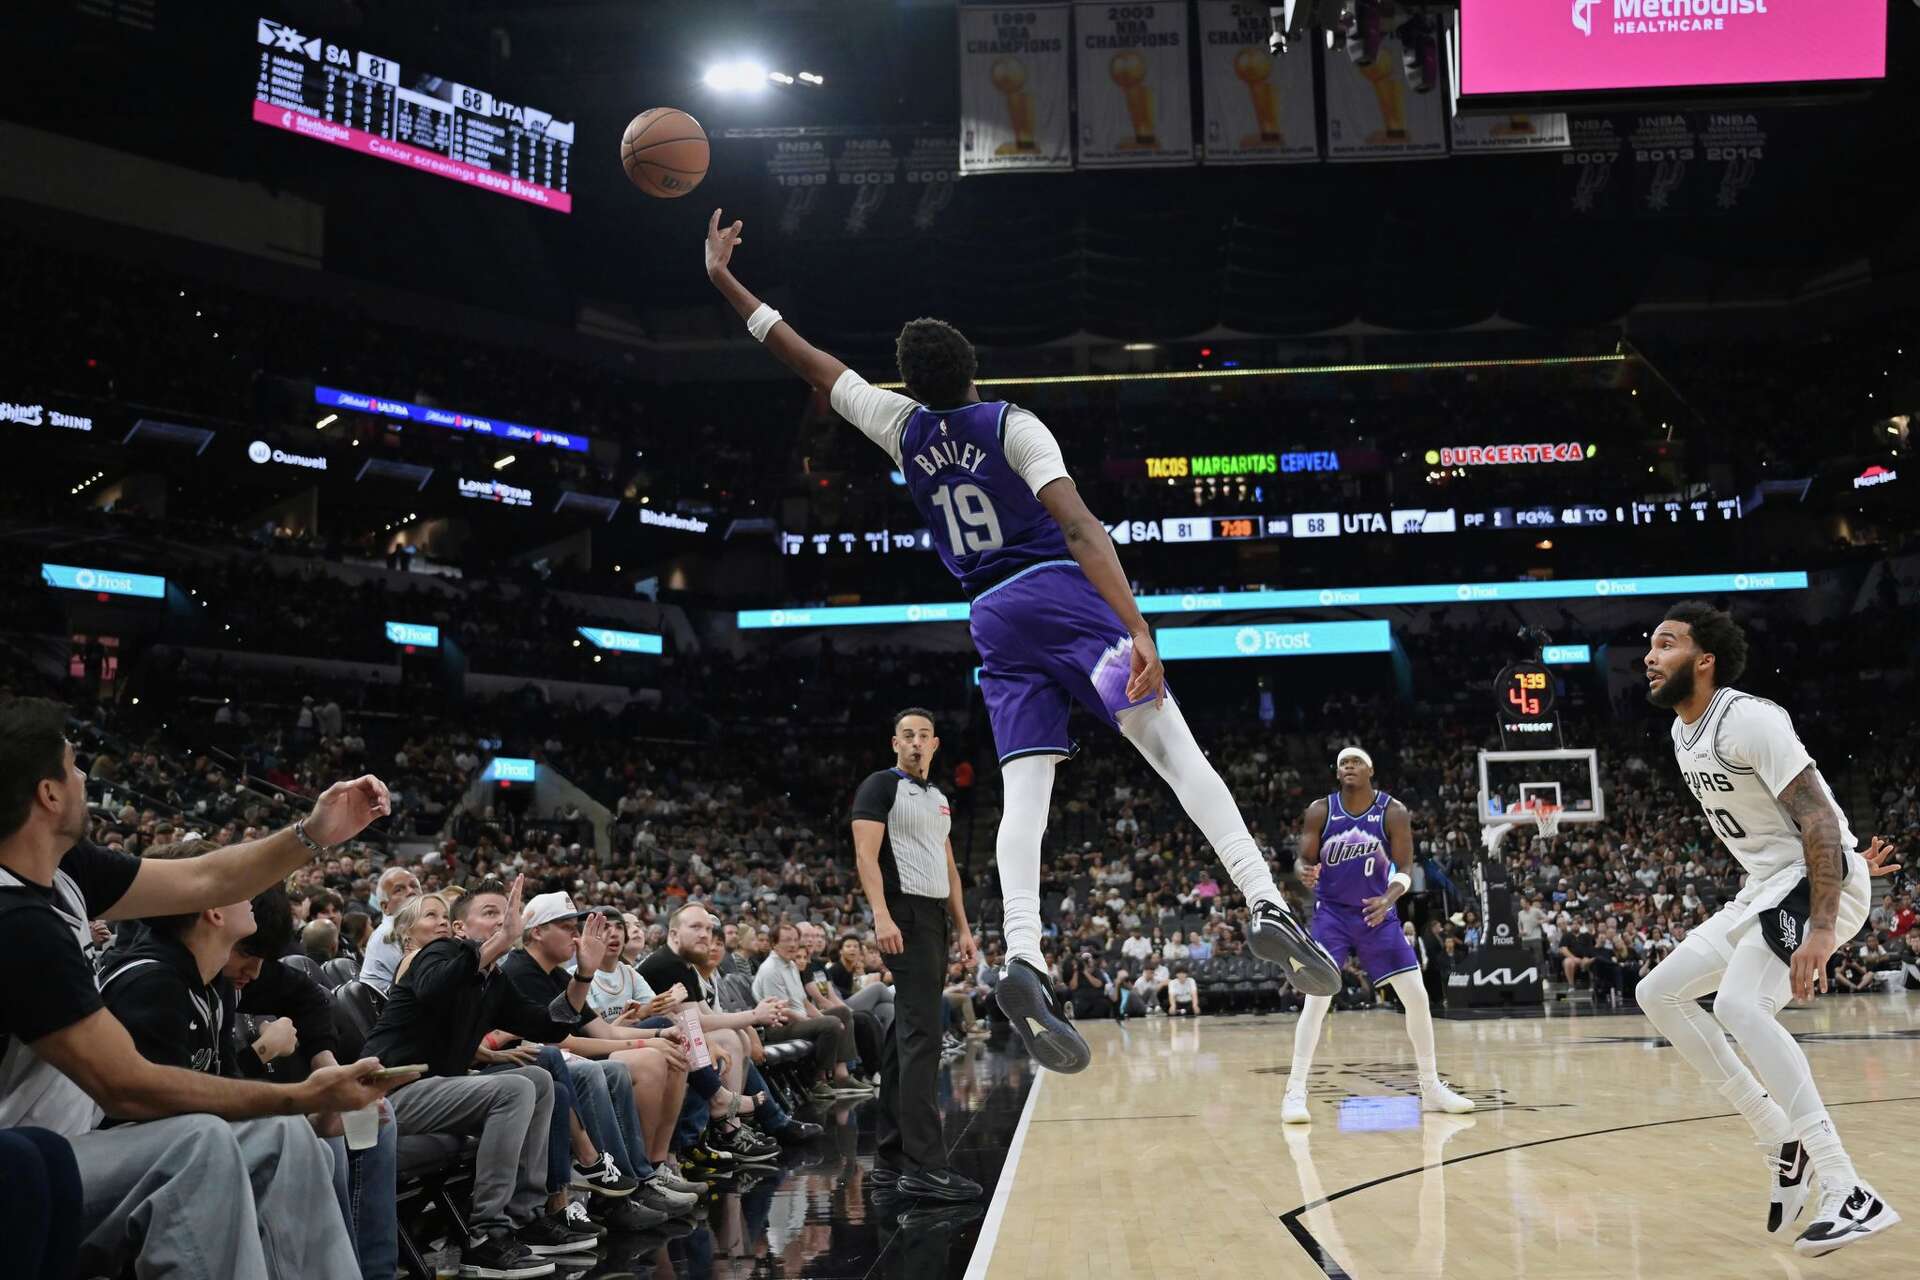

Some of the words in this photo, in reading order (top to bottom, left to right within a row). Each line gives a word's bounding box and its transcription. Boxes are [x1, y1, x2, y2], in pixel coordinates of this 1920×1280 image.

[1116, 20, 1148, 34] NBA
[1614, 18, 1723, 34] HEALTHCARE
[967, 38, 1061, 53] CHAMPIONS
[1085, 33, 1179, 49] CHAMPIONS
[325, 45, 351, 67] SA
[369, 58, 387, 80] 81
[463, 89, 482, 111] 68
[491, 98, 524, 124] UTA
[1563, 152, 1619, 165] 2007
[1636, 148, 1694, 162] 2013
[1706, 147, 1764, 160] 2014
[368, 139, 412, 162] Cancer
[414, 154, 476, 182] screenings
[477, 172, 510, 190] save
[273, 450, 327, 470] Ownwell
[914, 441, 986, 476] BAILEY
[1441, 443, 1584, 466] BURGERTECA
[1146, 457, 1188, 478] TACOS
[1191, 454, 1277, 476] MARGARITAS
[1280, 451, 1339, 472] CERVEZA
[931, 484, 1003, 556] 19
[1343, 512, 1387, 534] UTA
[1464, 513, 1485, 527] PF
[1516, 510, 1554, 524] FG%
[1585, 509, 1607, 522] TO
[1131, 521, 1161, 542] SA
[1177, 523, 1192, 537] 81
[1307, 518, 1325, 532] 68
[893, 534, 915, 548] TO
[97, 576, 132, 592] Frost
[1610, 582, 1637, 593] Frost
[1749, 576, 1775, 588] Frost
[1334, 592, 1360, 603] Frost
[406, 628, 432, 641] Frost
[615, 635, 640, 649] Frost
[1264, 630, 1311, 649] Frost
[1560, 649, 1584, 660] Frost
[1514, 673, 1546, 689] 7:39
[1517, 722, 1553, 732] TISSOT
[502, 764, 529, 777] Frost
[1683, 771, 1735, 796] PURS
[1326, 841, 1380, 866] UTAH
[1364, 857, 1376, 877] 0
[1492, 935, 1514, 946] Frost
